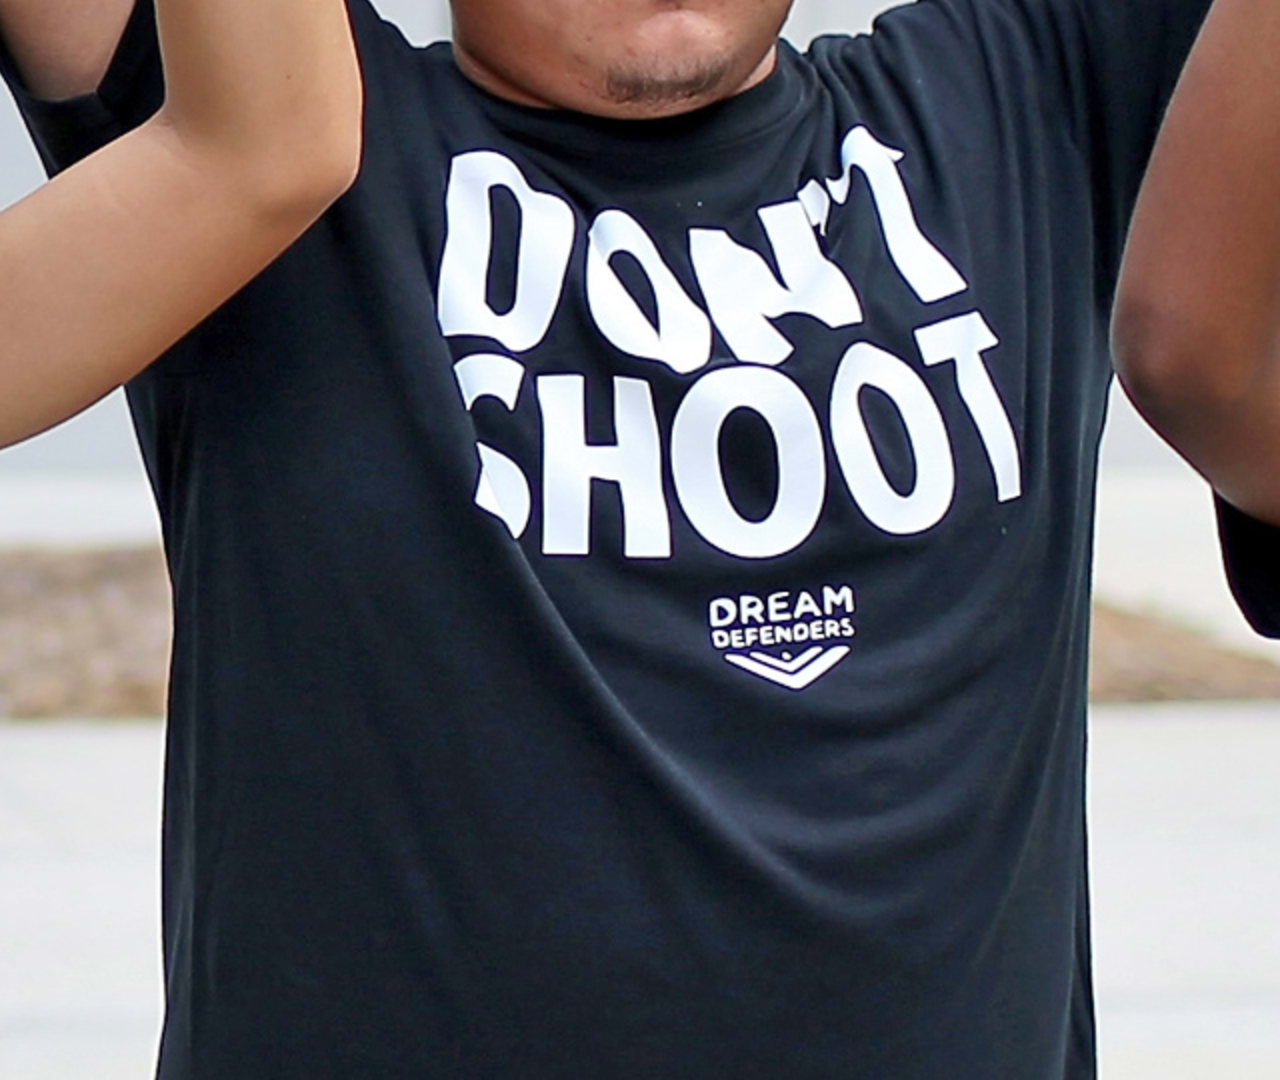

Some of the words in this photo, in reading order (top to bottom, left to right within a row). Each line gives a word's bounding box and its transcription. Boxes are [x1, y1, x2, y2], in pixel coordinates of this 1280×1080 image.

[436, 124, 969, 375] DON'T
[453, 310, 1021, 558] SHOOT
[709, 585, 855, 628] DREAM
[711, 617, 856, 649] DEFENDERS
